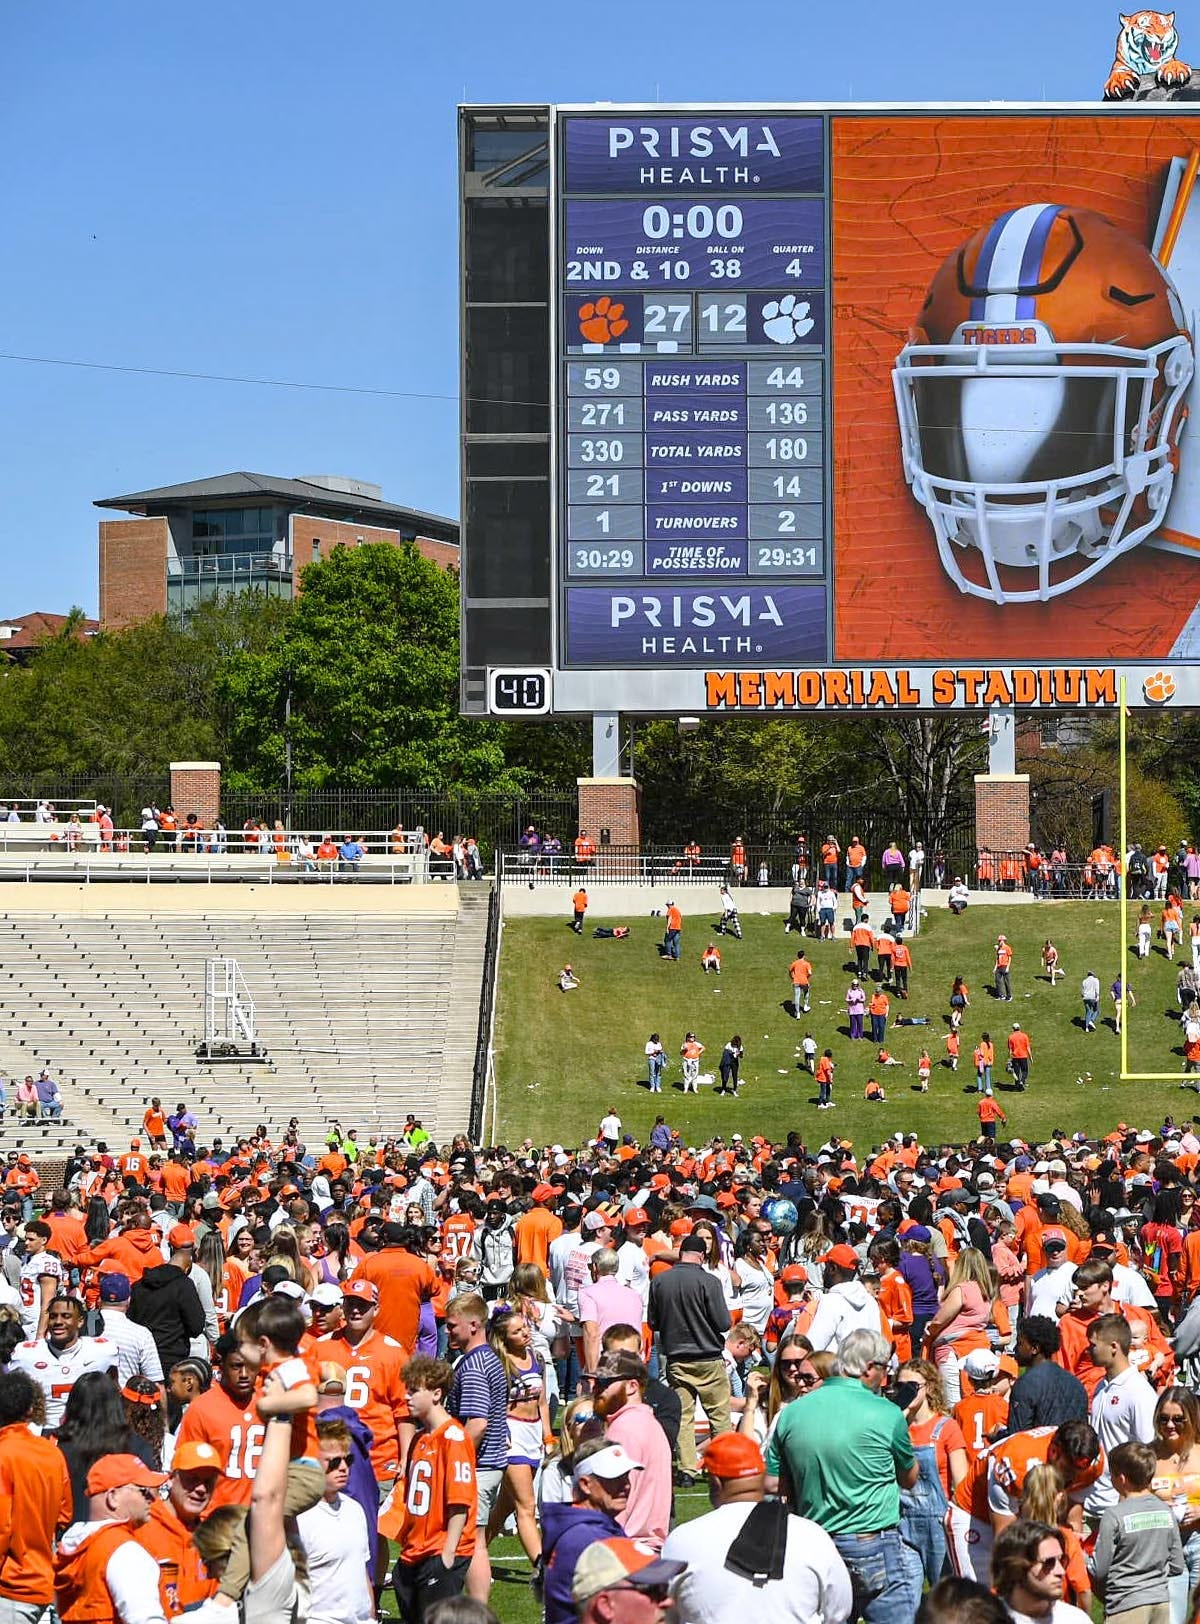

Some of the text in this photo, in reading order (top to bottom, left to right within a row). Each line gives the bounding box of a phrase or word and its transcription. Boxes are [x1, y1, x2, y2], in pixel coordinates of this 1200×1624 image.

[608, 126, 781, 158] PRISMA
[642, 205, 743, 238] 0:00
[576, 246, 604, 254] DOWN
[636, 246, 680, 254] DISTANCE
[773, 245, 814, 253] QUARTER
[566, 260, 690, 280] 2ND & 10
[710, 259, 741, 278] 38
[785, 258, 802, 277] 4
[644, 305, 690, 332] 27
[702, 304, 747, 332] 12
[961, 328, 1037, 345] TIGERS
[584, 368, 620, 390] 59
[652, 374, 740, 386] RUSH YARDS
[767, 367, 804, 388] 44
[581, 403, 625, 425] 271
[653, 410, 738, 422] PASS YARDS
[766, 402, 808, 424] 136
[581, 440, 624, 462] 330
[651, 446, 742, 457] TOTAL YARDS
[766, 438, 808, 460] 180
[587, 475, 620, 496] 21
[681, 481, 732, 493] DOWNS
[773, 475, 801, 497] 14
[596, 511, 610, 532] 1
[655, 517, 738, 528] TURNOVERS
[778, 510, 796, 532] 2
[576, 550, 634, 568] 30:29
[669, 547, 725, 558] TIME OF
[758, 548, 816, 566] 29:31
[652, 558, 741, 569] POSSESSION
[611, 595, 784, 628] PRISMA
[500, 676, 540, 706] 40
[705, 668, 1118, 708] MEMORIAL STADIUM
[126, 1157, 140, 1171] 16
[44, 1262, 58, 1273] 29
[972, 1411, 985, 1449] 1
[454, 1461, 471, 1482] 16
